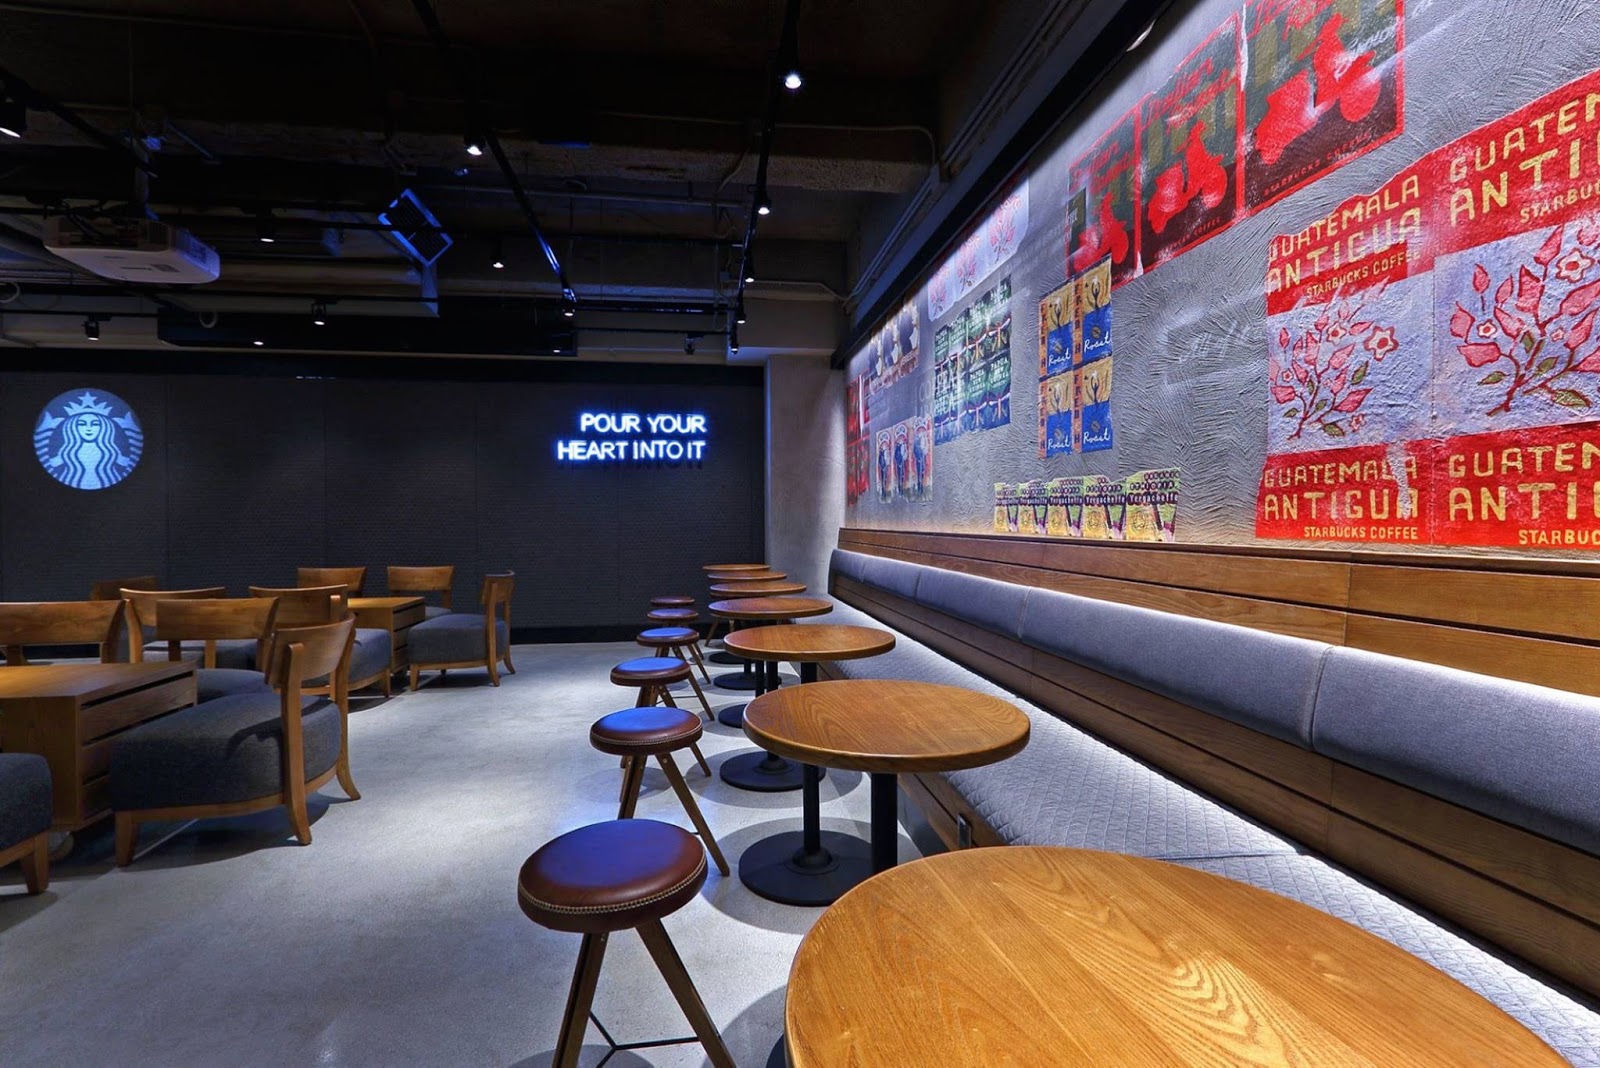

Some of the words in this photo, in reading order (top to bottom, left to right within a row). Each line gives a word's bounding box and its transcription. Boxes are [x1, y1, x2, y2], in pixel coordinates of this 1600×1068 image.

[1450, 130, 1600, 228] ANTI
[1266, 207, 1421, 297] ANTIGUA
[1305, 265, 1369, 298] STARBUCKS
[1372, 249, 1421, 276] COFFEE
[580, 412, 642, 433] POUR
[647, 413, 707, 433] YOUR
[557, 440, 629, 460] HEART
[632, 440, 684, 460] INTO
[686, 440, 706, 460] IT
[1264, 455, 1418, 488] GUATEMALA
[1264, 487, 1419, 521] ANTIGUA
[1448, 481, 1600, 521] ANTI
[1303, 525, 1367, 538] STARBUCKS
[1370, 525, 1419, 540] COFFEE
[1518, 528, 1600, 545] STARBUC
